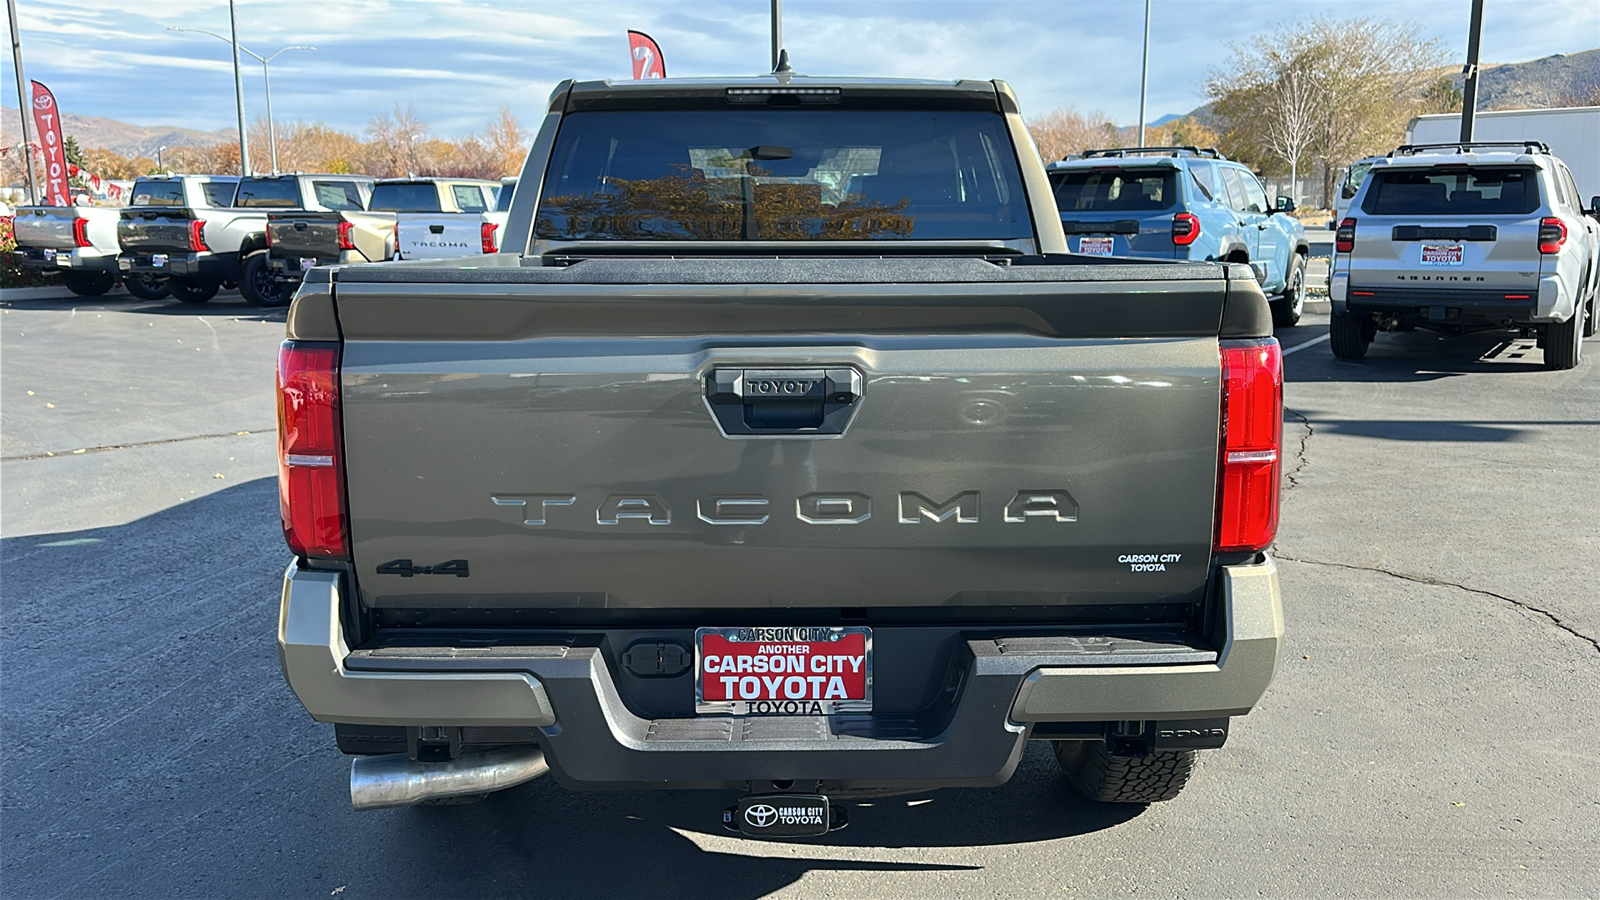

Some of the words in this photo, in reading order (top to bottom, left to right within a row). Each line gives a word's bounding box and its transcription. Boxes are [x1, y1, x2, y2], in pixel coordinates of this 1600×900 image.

[41, 114, 67, 206] TOYOTA
[747, 380, 822, 394] TOYOTA
[491, 489, 1079, 525] TACOMA
[1117, 554, 1159, 563] CARSON
[1160, 554, 1182, 563] CITY
[1130, 563, 1166, 572] TOYOTA
[737, 628, 797, 642] CARSON
[799, 628, 831, 642] CITY
[758, 645, 810, 654] ANOTHER
[704, 655, 805, 673] CARSON
[810, 655, 865, 673] CITY
[720, 676, 848, 700] TOYOTA
[745, 701, 823, 715] TOYOTA
[779, 807, 806, 816] CARSON
[807, 807, 824, 816] CITY
[780, 816, 823, 824] TOYOTA
